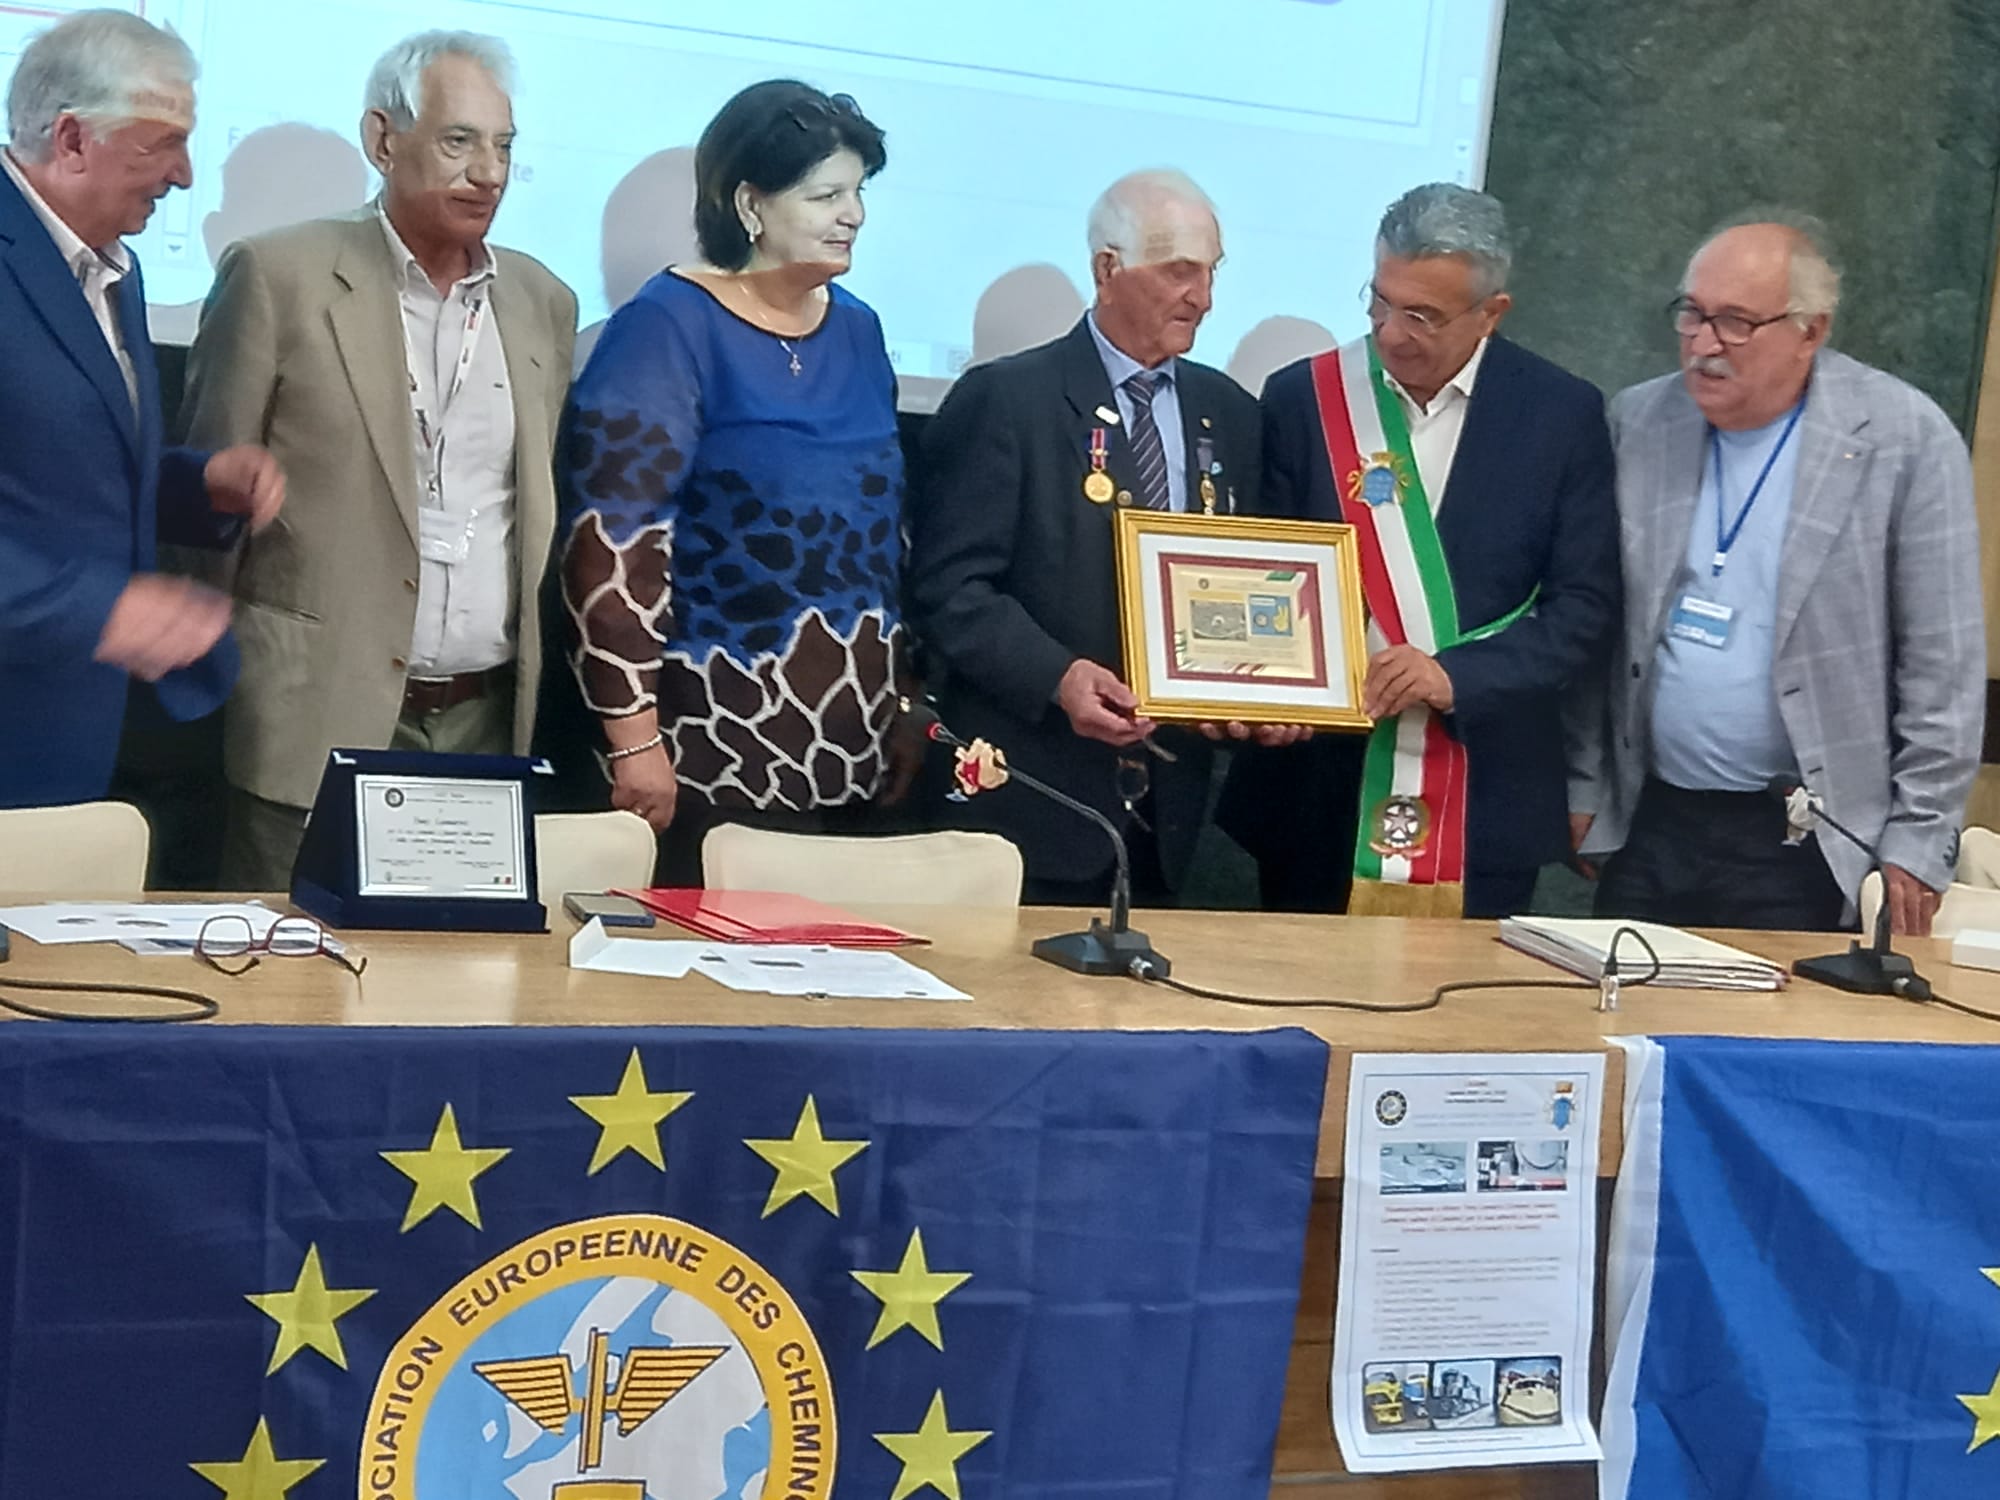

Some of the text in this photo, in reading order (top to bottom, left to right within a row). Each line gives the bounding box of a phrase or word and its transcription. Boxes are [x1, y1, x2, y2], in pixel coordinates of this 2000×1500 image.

[371, 1229, 822, 1500] CIATION EUROPEENNE DES CHEMIN
